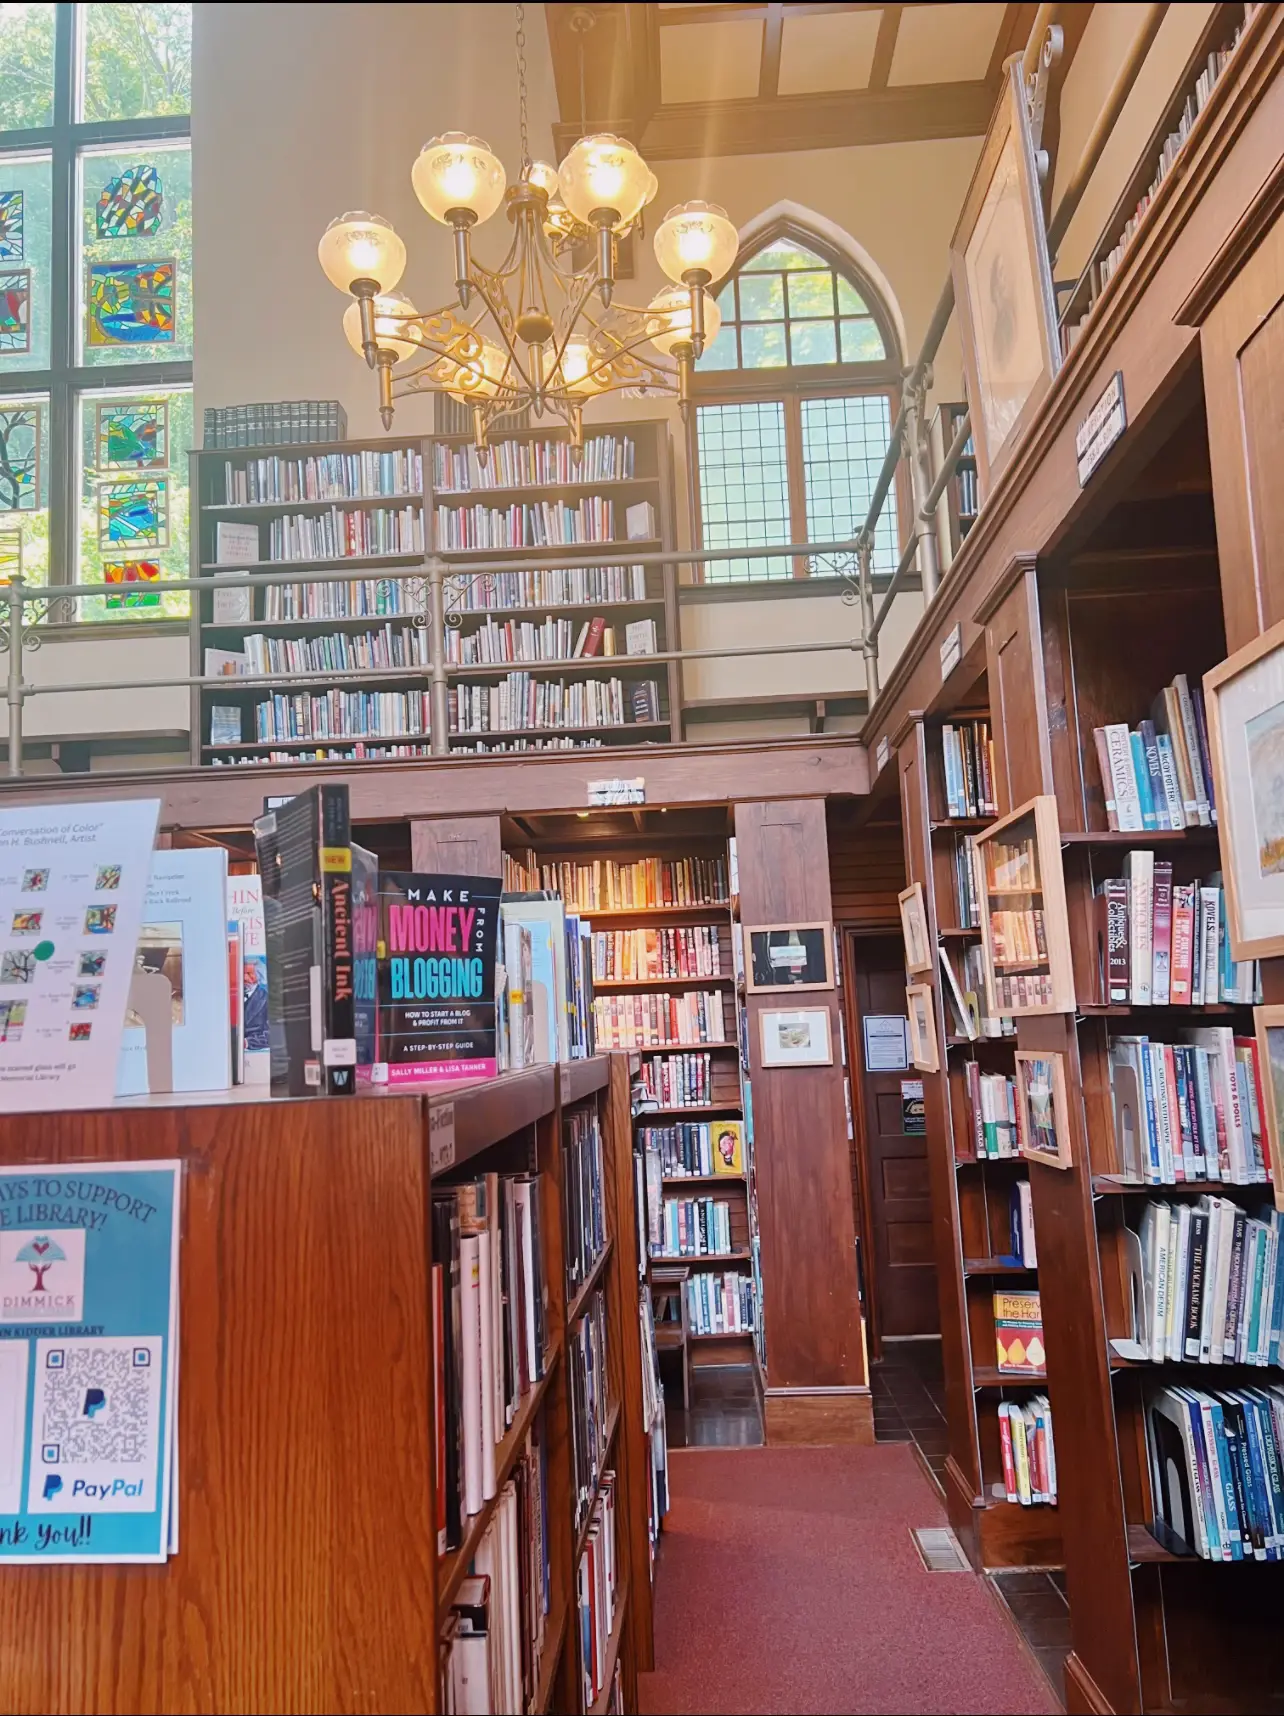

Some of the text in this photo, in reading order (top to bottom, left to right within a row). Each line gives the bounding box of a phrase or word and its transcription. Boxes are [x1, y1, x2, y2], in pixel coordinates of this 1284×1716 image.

[1110, 731, 1128, 797] CERAMICS
[1161, 753, 1175, 802] McCOY POTTERY
[407, 888, 470, 902] MAKE
[389, 904, 477, 953] MONEY
[475, 907, 486, 953] FROM
[1108, 901, 1117, 952] Collectibles
[1116, 902, 1127, 939] Antiques
[1204, 900, 1216, 933] KOVELS'
[331, 879, 353, 1002] Ancient Ink
[1181, 937, 1189, 968] CULTURE
[1110, 958, 1127, 966] 2013
[390, 957, 484, 999] BLOGGING
[405, 1011, 420, 1019] HOW
[431, 1010, 449, 1018] START
[455, 1009, 471, 1017] BLOG
[412, 1019, 418, 1027] &
[409, 1042, 454, 1052] STEP-BY-STEP
[455, 1041, 474, 1049] GUIDE
[391, 1063, 486, 1077] SALLY MILLER & LISA TANNER
[1158, 1068, 1170, 1144] CREATING WITH PAPER
[1229, 1072, 1237, 1092] TOYS
[1233, 1103, 1241, 1128] DOLLS
[32, 1179, 61, 1198] TO
[64, 1180, 157, 1223] SUPPORT
[17, 1203, 108, 1231] LIBRARY!
[1194, 1245, 1202, 1264] THE
[1157, 1247, 1166, 1317] AMERICAN DENIM
[3, 1295, 75, 1308] DIMMICK
[1002, 1297, 1040, 1309] Preserv
[1003, 1308, 1040, 1319] the Har
[58, 1325, 105, 1336] LIBRARY
[1189, 1307, 1200, 1329] BOOK
[1241, 1442, 1250, 1468] Pressed
[1265, 1434, 1276, 1474] DEPRESSION
[72, 1479, 144, 1500] PayPal
[1225, 1483, 1236, 1512] GLASS
[1270, 1474, 1280, 1494] GLASS
